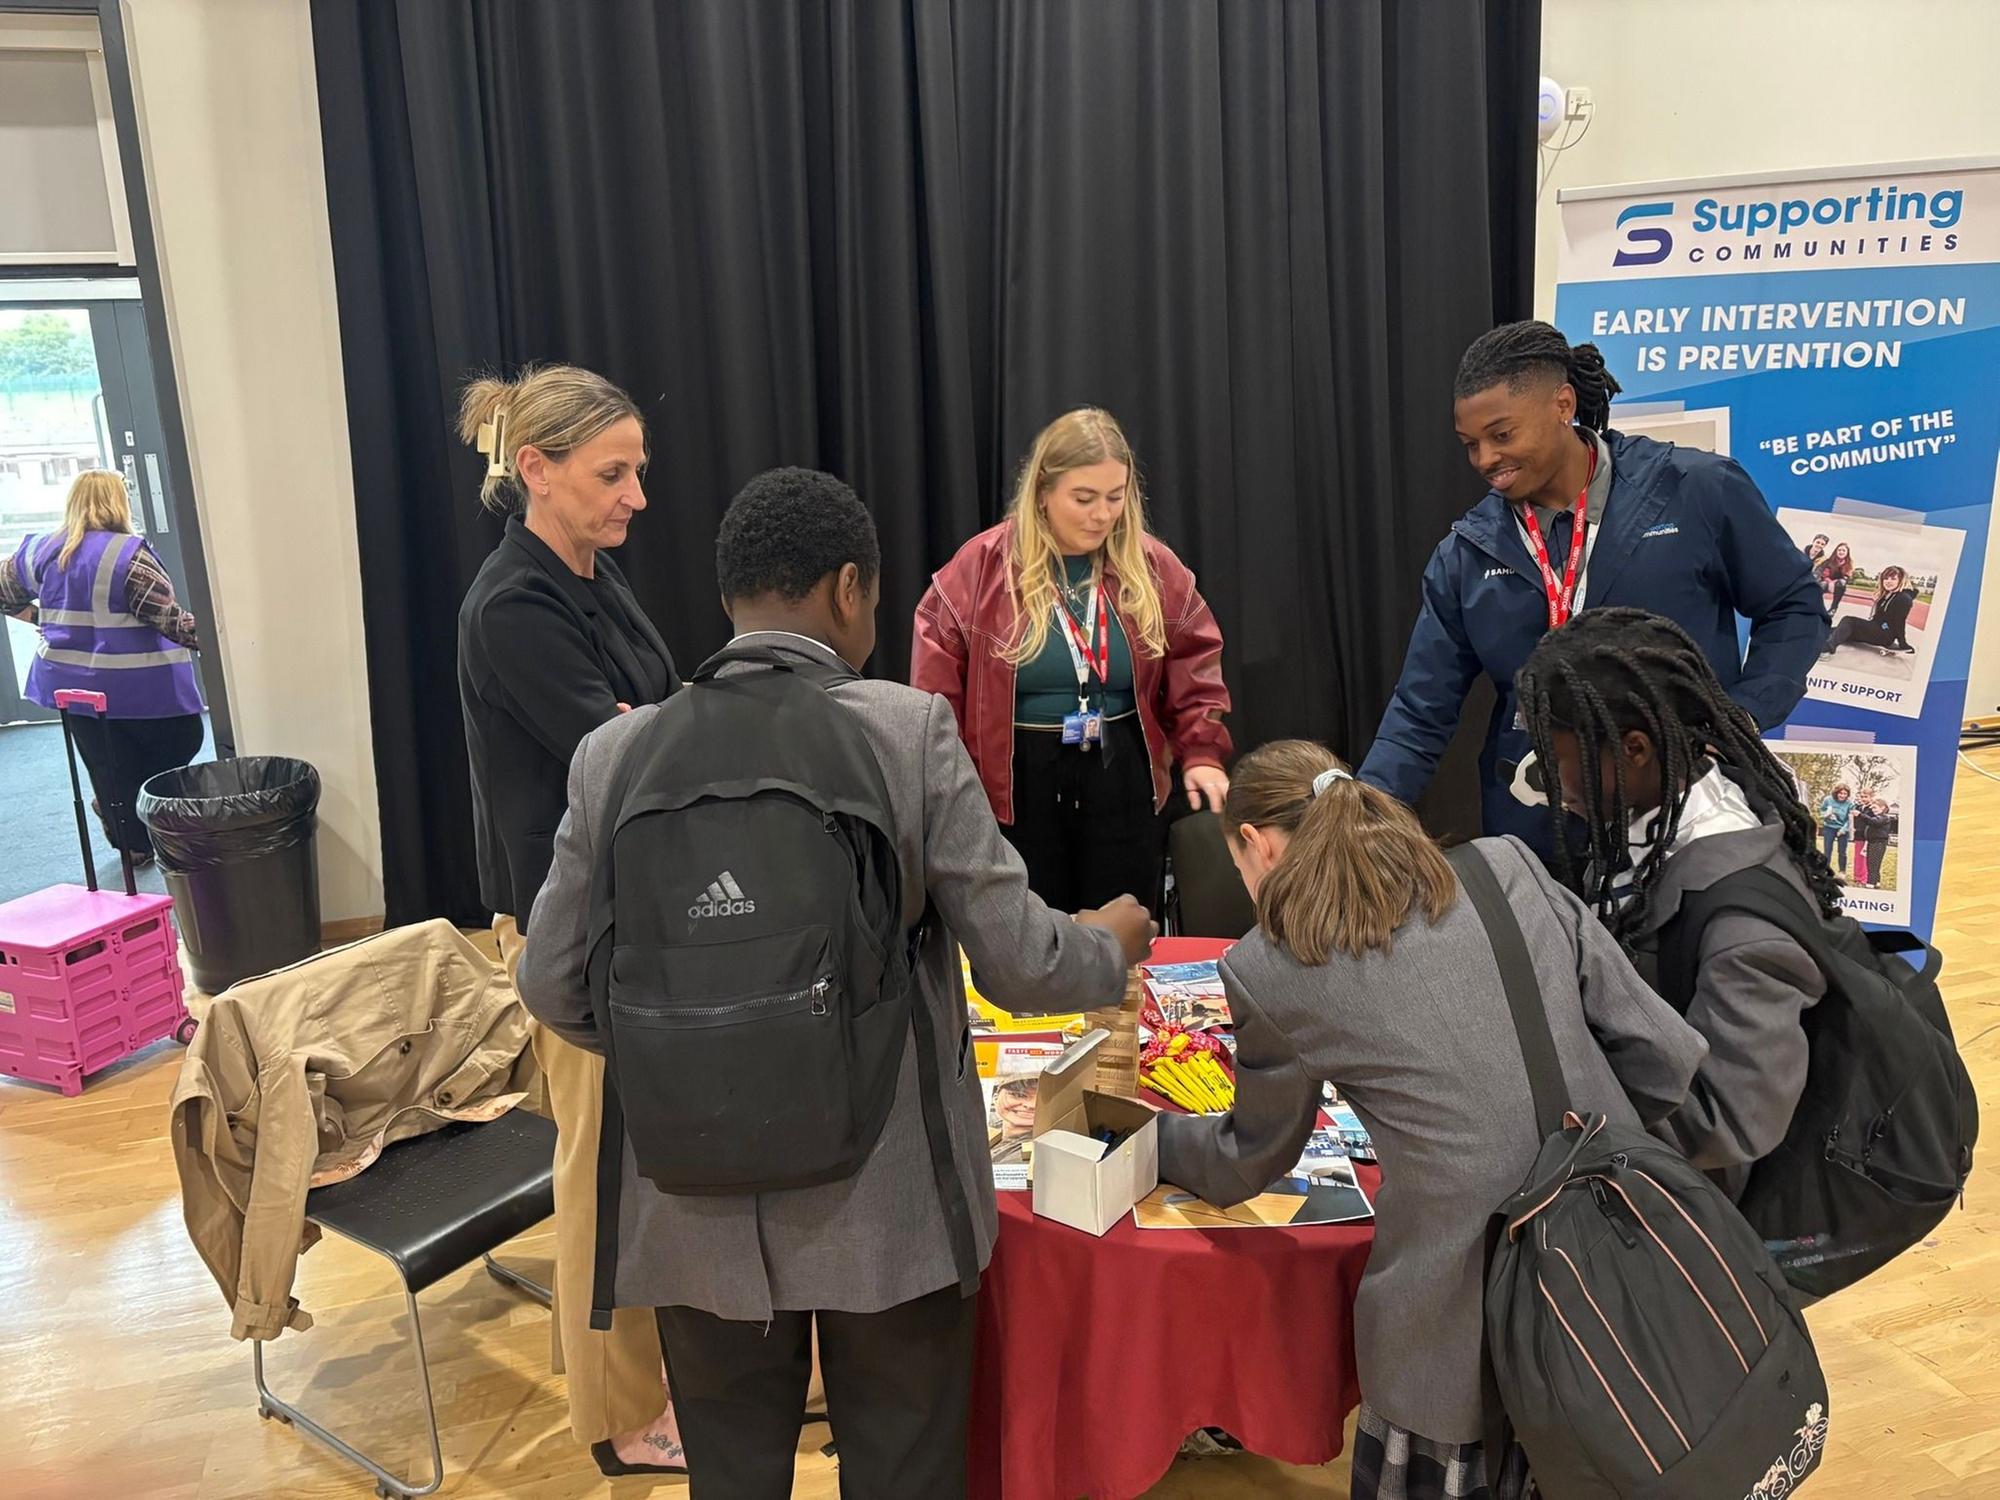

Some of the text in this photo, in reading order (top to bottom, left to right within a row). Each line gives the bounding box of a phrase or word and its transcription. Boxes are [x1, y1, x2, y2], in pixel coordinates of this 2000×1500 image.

[1692, 186, 1963, 236] Supporting
[1688, 234, 1959, 263] COMMUNITIES
[1592, 297, 1966, 336] EARLY INTERVENTION
[1637, 341, 1902, 372] IS PREVENTION
[1806, 424, 1863, 450] PART
[1870, 418, 1903, 439] OF
[1909, 409, 1954, 432] THE
[1840, 683, 1902, 702] SUPPORT
[687, 899, 756, 919] adidas
